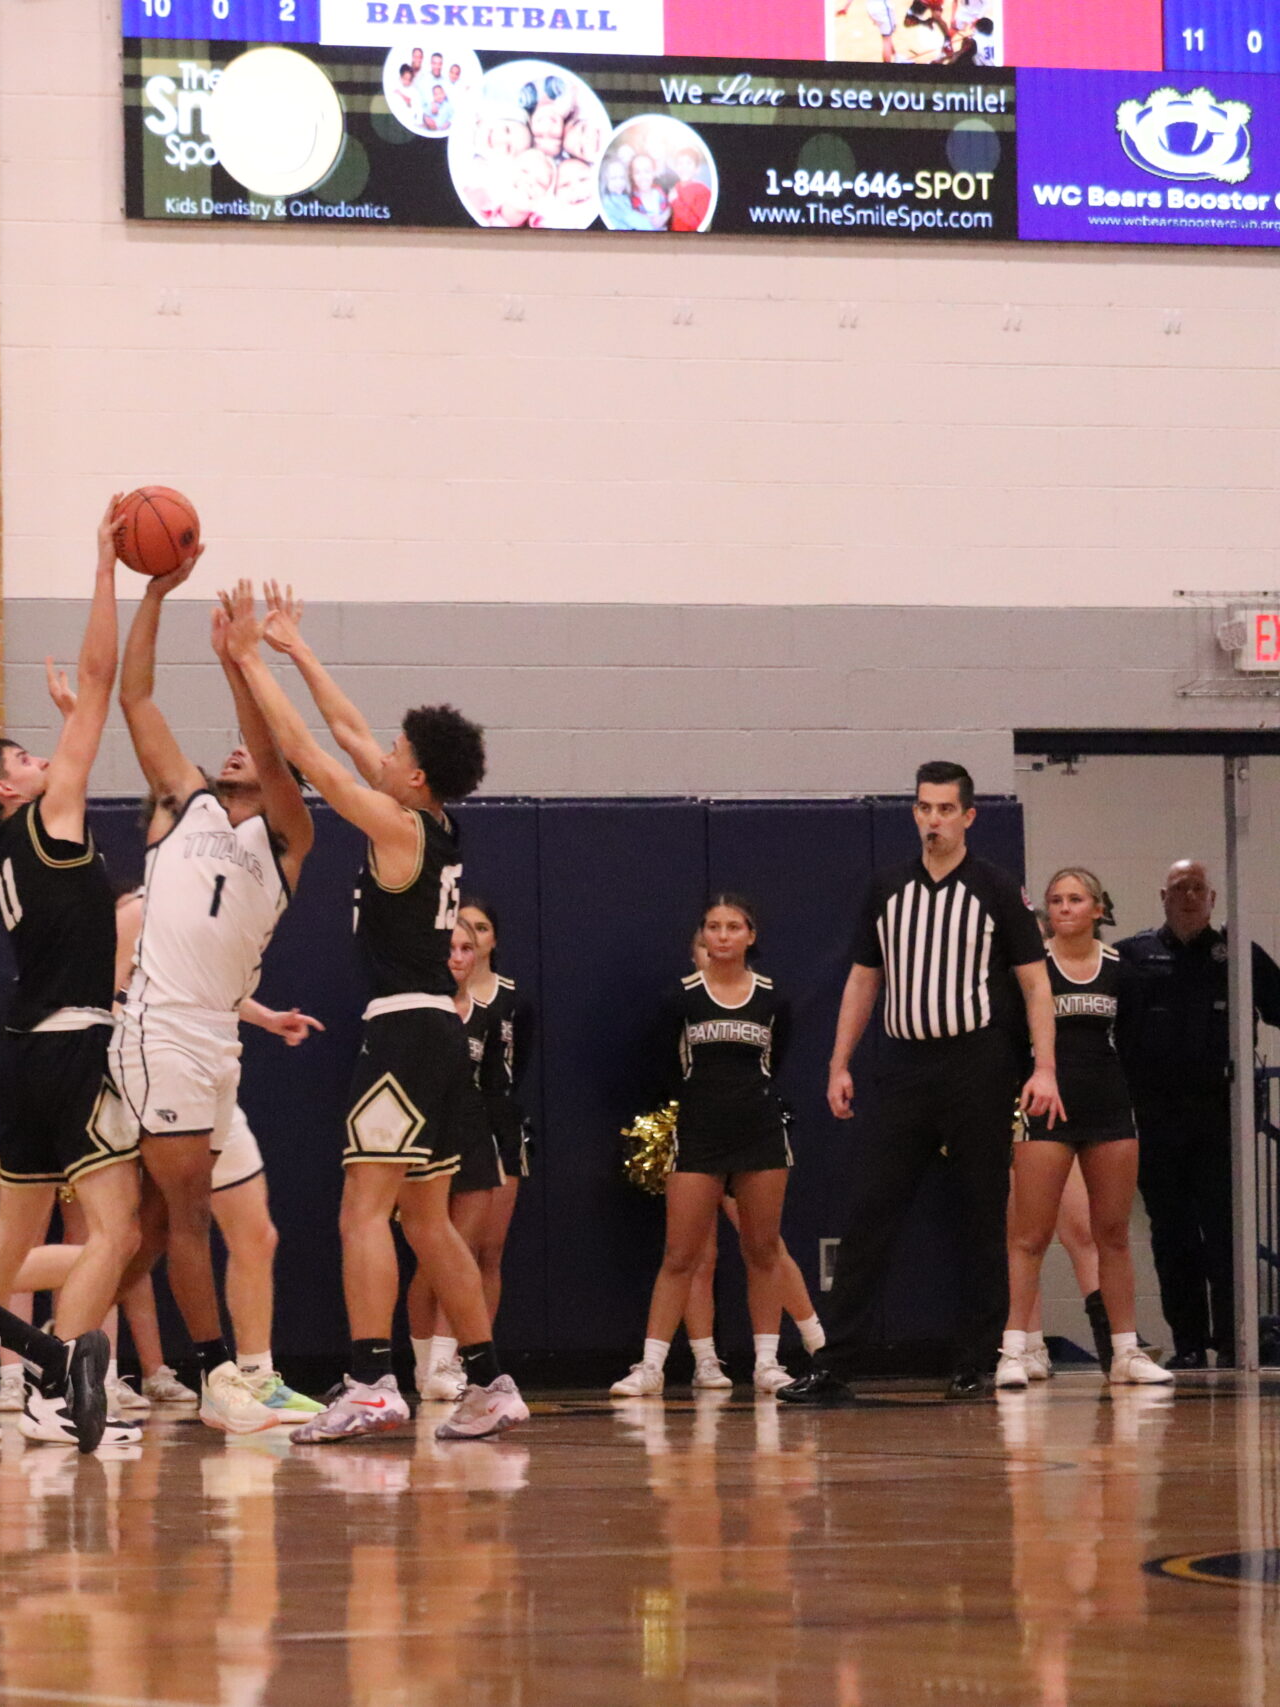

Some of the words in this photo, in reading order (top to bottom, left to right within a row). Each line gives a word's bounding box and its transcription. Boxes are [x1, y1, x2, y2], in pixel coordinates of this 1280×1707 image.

[142, 0, 171, 17] 10
[212, 0, 229, 20] 0
[279, 0, 296, 22] 2
[366, 2, 618, 31] BASKETBALL
[1182, 27, 1205, 52] 11
[1247, 29, 1263, 54] 0
[660, 77, 703, 105] We
[711, 72, 786, 107] Love
[797, 83, 823, 108] to
[830, 88, 872, 110] see
[879, 90, 925, 117] you
[932, 85, 1006, 113] smile!
[164, 133, 221, 172] Spo
[766, 168, 995, 201] 1-844-646-SPOT
[1033, 184, 1083, 207] WC
[1088, 186, 1162, 209] Bears
[1168, 187, 1270, 211] Booster
[165, 197, 198, 215] Kids
[201, 197, 271, 220] Dentistry
[273, 200, 287, 217] &
[290, 200, 391, 220] Orthodontics
[748, 203, 994, 232] www.TheSmileSpot.com
[209, 874, 227, 917] 1
[1053, 994, 1118, 1016] NTHERS
[686, 1022, 771, 1046] PANTHERS
